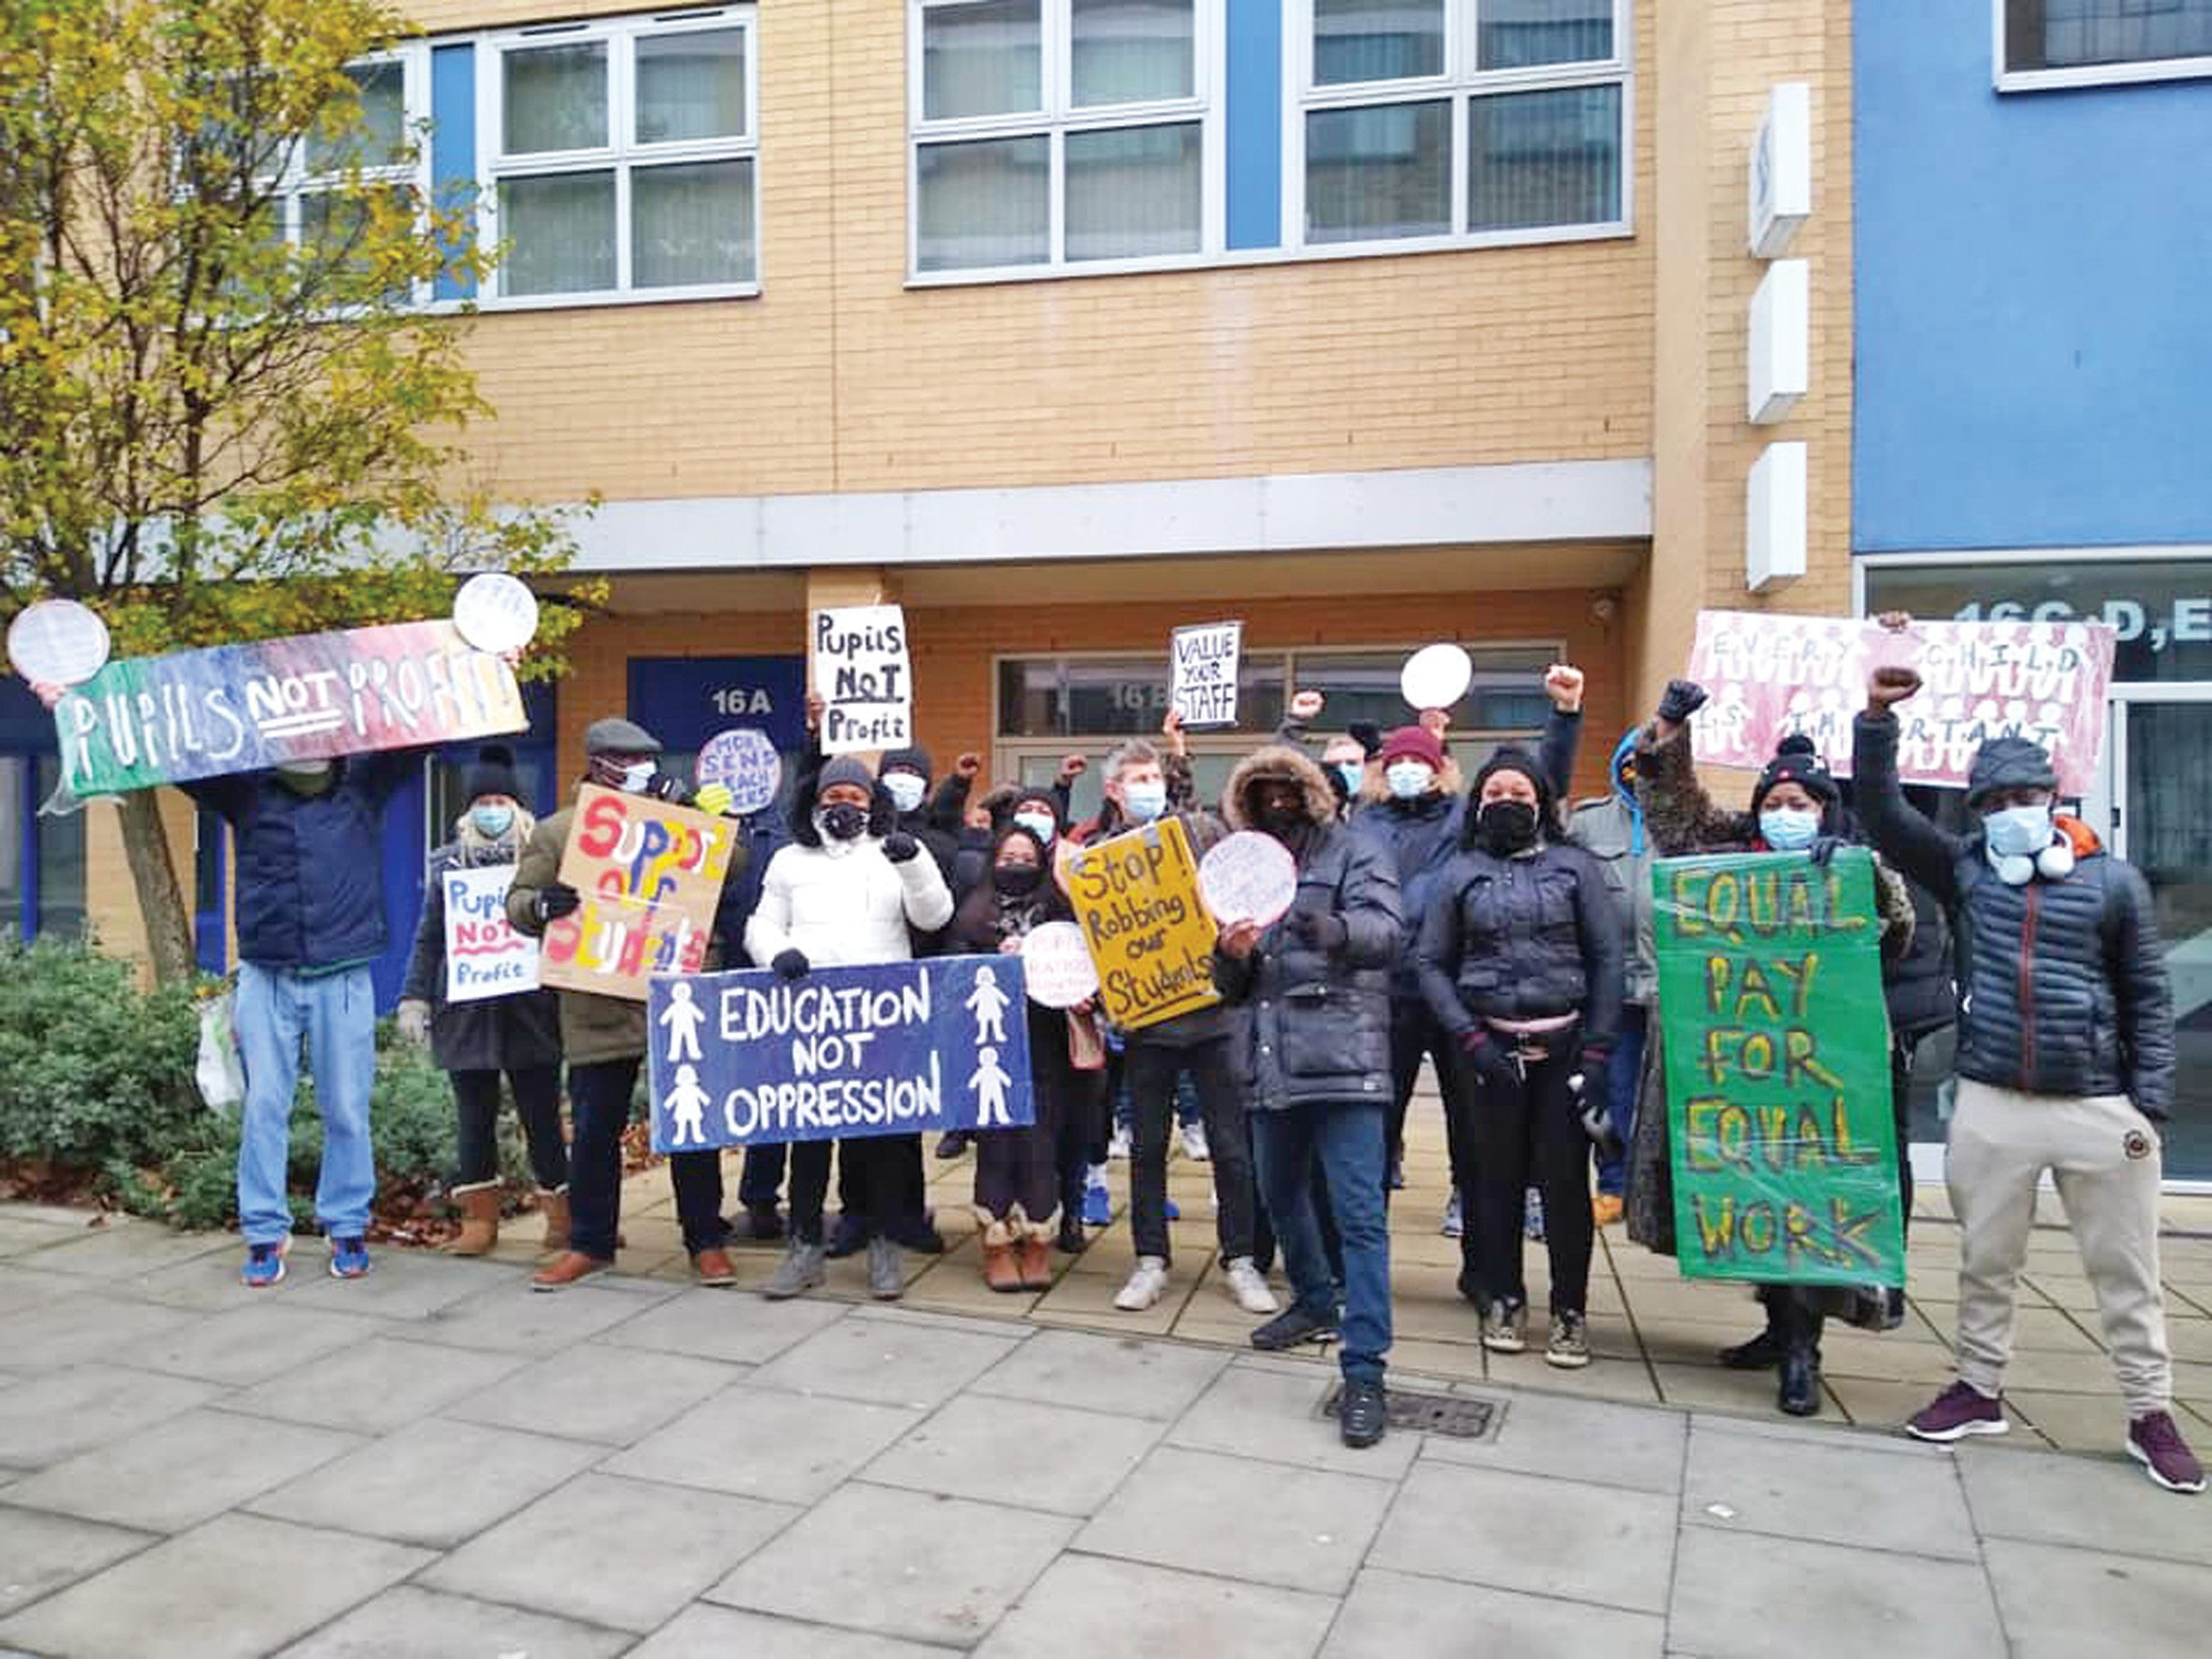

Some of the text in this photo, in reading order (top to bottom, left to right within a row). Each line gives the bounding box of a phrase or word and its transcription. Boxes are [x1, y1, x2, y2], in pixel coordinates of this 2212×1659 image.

[818, 614, 902, 659] Pupils
[1177, 632, 1233, 664] VALUE
[1713, 630, 2080, 672] EVERY CHILD
[1183, 661, 1222, 684] YOUR
[1175, 682, 1234, 721] STAFF
[74, 683, 243, 780] PUPILS
[246, 672, 339, 720] NOT
[828, 710, 903, 743] Profit
[1792, 710, 2061, 747] IMRTANT
[449, 879, 506, 920] Pupi
[1671, 866, 1868, 945] EQUAL
[1126, 927, 1167, 959] our
[457, 961, 524, 986] Profit
[1705, 951, 1820, 1019] PAY
[719, 965, 930, 1041] EDUCATION
[792, 1031, 874, 1076] NOT
[1697, 1025, 1843, 1090] FOR
[724, 1049, 941, 1136] OPPRESSION
[1686, 1094, 1882, 1175] EQUAL
[1694, 1193, 1882, 1270] WORK
